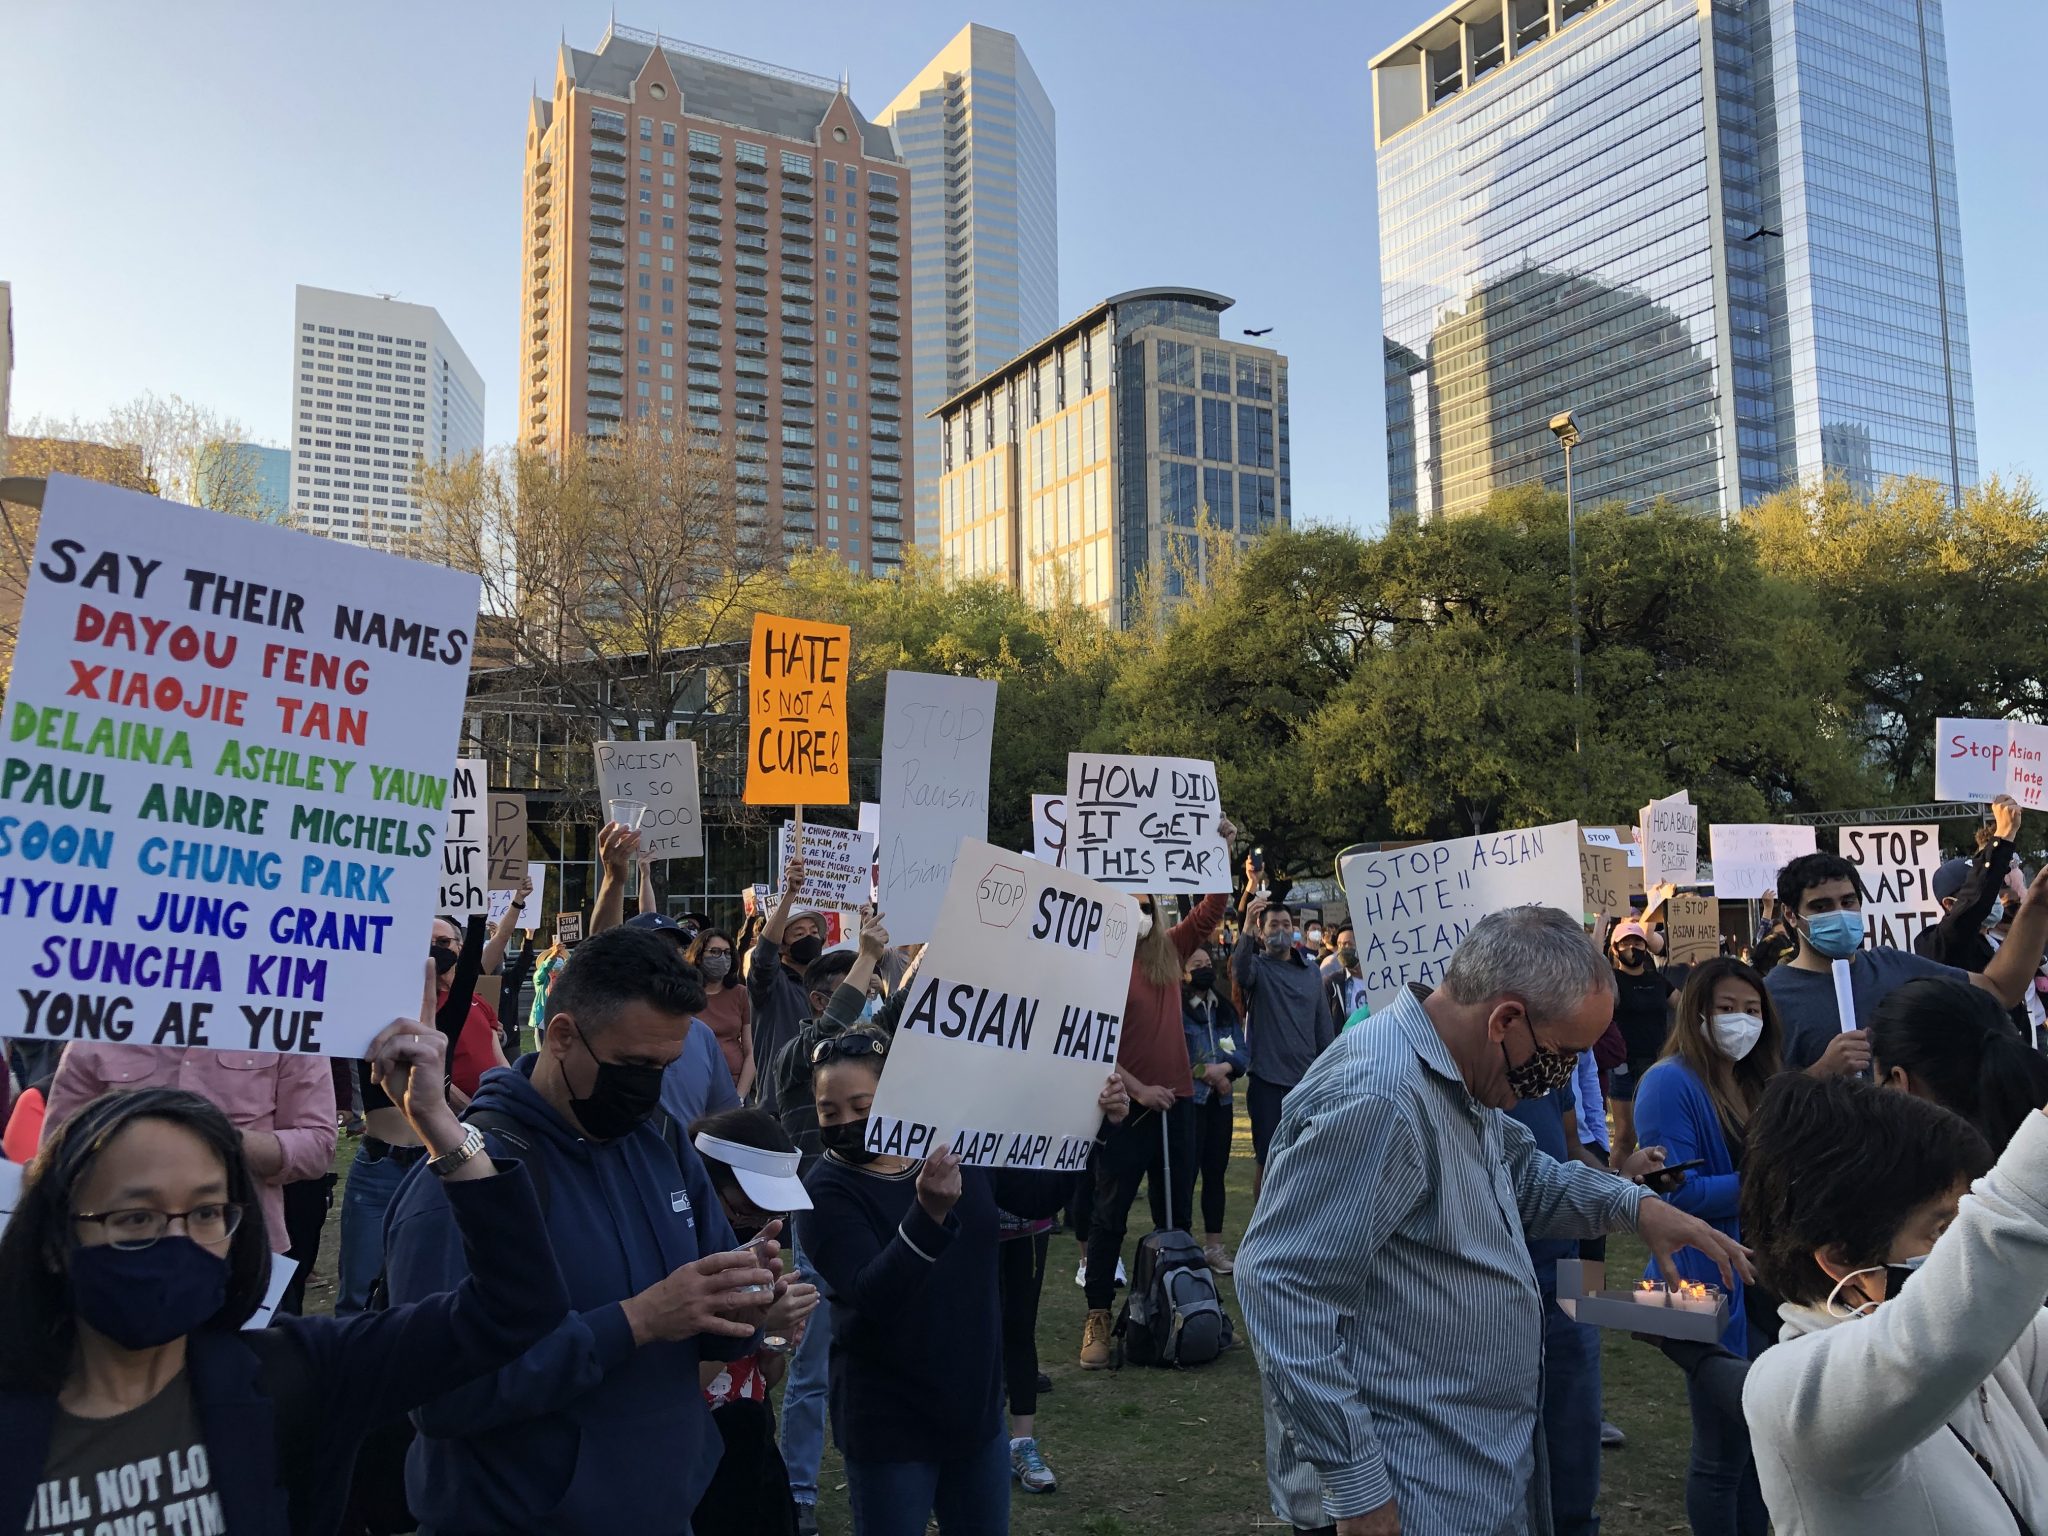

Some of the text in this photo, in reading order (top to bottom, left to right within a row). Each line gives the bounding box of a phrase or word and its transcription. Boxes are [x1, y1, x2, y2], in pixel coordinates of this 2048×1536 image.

[40, 539, 468, 666] SAY THEIR NAMES
[74, 603, 370, 696] DAYOU FENG
[765, 628, 841, 683] HATE
[65, 660, 369, 746] XIAOJIE TAN
[757, 689, 835, 716] IS NOT A
[892, 702, 985, 759] STOP
[10, 702, 449, 811] DELAINA ASHLEY YAUN
[598, 746, 682, 773] RACISM
[758, 727, 840, 777] CURE!
[1951, 735, 2041, 771] Stop Asian
[452, 768, 476, 799] M
[617, 781, 673, 796] IS SO
[1078, 763, 1216, 802] HOW DID
[2014, 767, 2043, 785] Hate
[1, 758, 436, 858] PAUL ANDRE MICHELS
[2024, 788, 2041, 805] !!!
[450, 809, 475, 837] T
[639, 807, 692, 828] OOO
[1078, 811, 1121, 839] IT
[1139, 812, 1209, 838] GET
[1654, 809, 1668, 832] HAD
[1670, 812, 1675, 831] A
[786, 834, 815, 845] SUCHA
[837, 842, 848, 851] 69
[808, 827, 831, 837] CHUNG
[832, 830, 850, 841] PARK,
[853, 833, 861, 842] 74
[1846, 830, 1928, 866] STOP
[0, 815, 395, 904] SOON CHUNG PARK
[785, 844, 850, 862] YOG AE YUE, 63
[804, 859, 825, 868] ANDRE
[827, 862, 855, 874] MICHELS,
[858, 866, 866, 875] 54
[1077, 846, 1224, 878] THIS FAR?
[1366, 830, 1545, 888] STOP ASIAN
[1662, 854, 1686, 869] RACISM
[805, 868, 861, 885] JUNG GRANT, 51
[886, 833, 946, 902] Asian
[1592, 874, 1600, 886] A
[503, 890, 511, 899] A
[812, 888, 832, 899] FENG,
[817, 880, 834, 890] TAN,
[837, 884, 846, 892] 49
[980, 880, 1024, 907] STOP
[0, 877, 393, 954] HYUN JUNG GRANT
[814, 899, 838, 909] ASHLEY
[841, 902, 858, 912] YAUN,
[1032, 887, 1102, 950] STOP
[1672, 901, 1708, 916] # STOP
[561, 917, 577, 925] STOP
[561, 924, 578, 932] ASIAN
[1105, 919, 1128, 940] STOP
[1672, 925, 1716, 939] ASIAN HATE
[562, 932, 577, 940] HATE
[1367, 917, 1470, 963] ASIAN
[32, 935, 327, 1001] SUNCHA KIM
[19, 989, 324, 1053] YONG AE YUE
[904, 977, 1119, 1064] ASIAN HATE
[867, 1116, 1095, 1170] AAPI AAPI AAPI AAP
[96, 1456, 162, 1517] NOT
